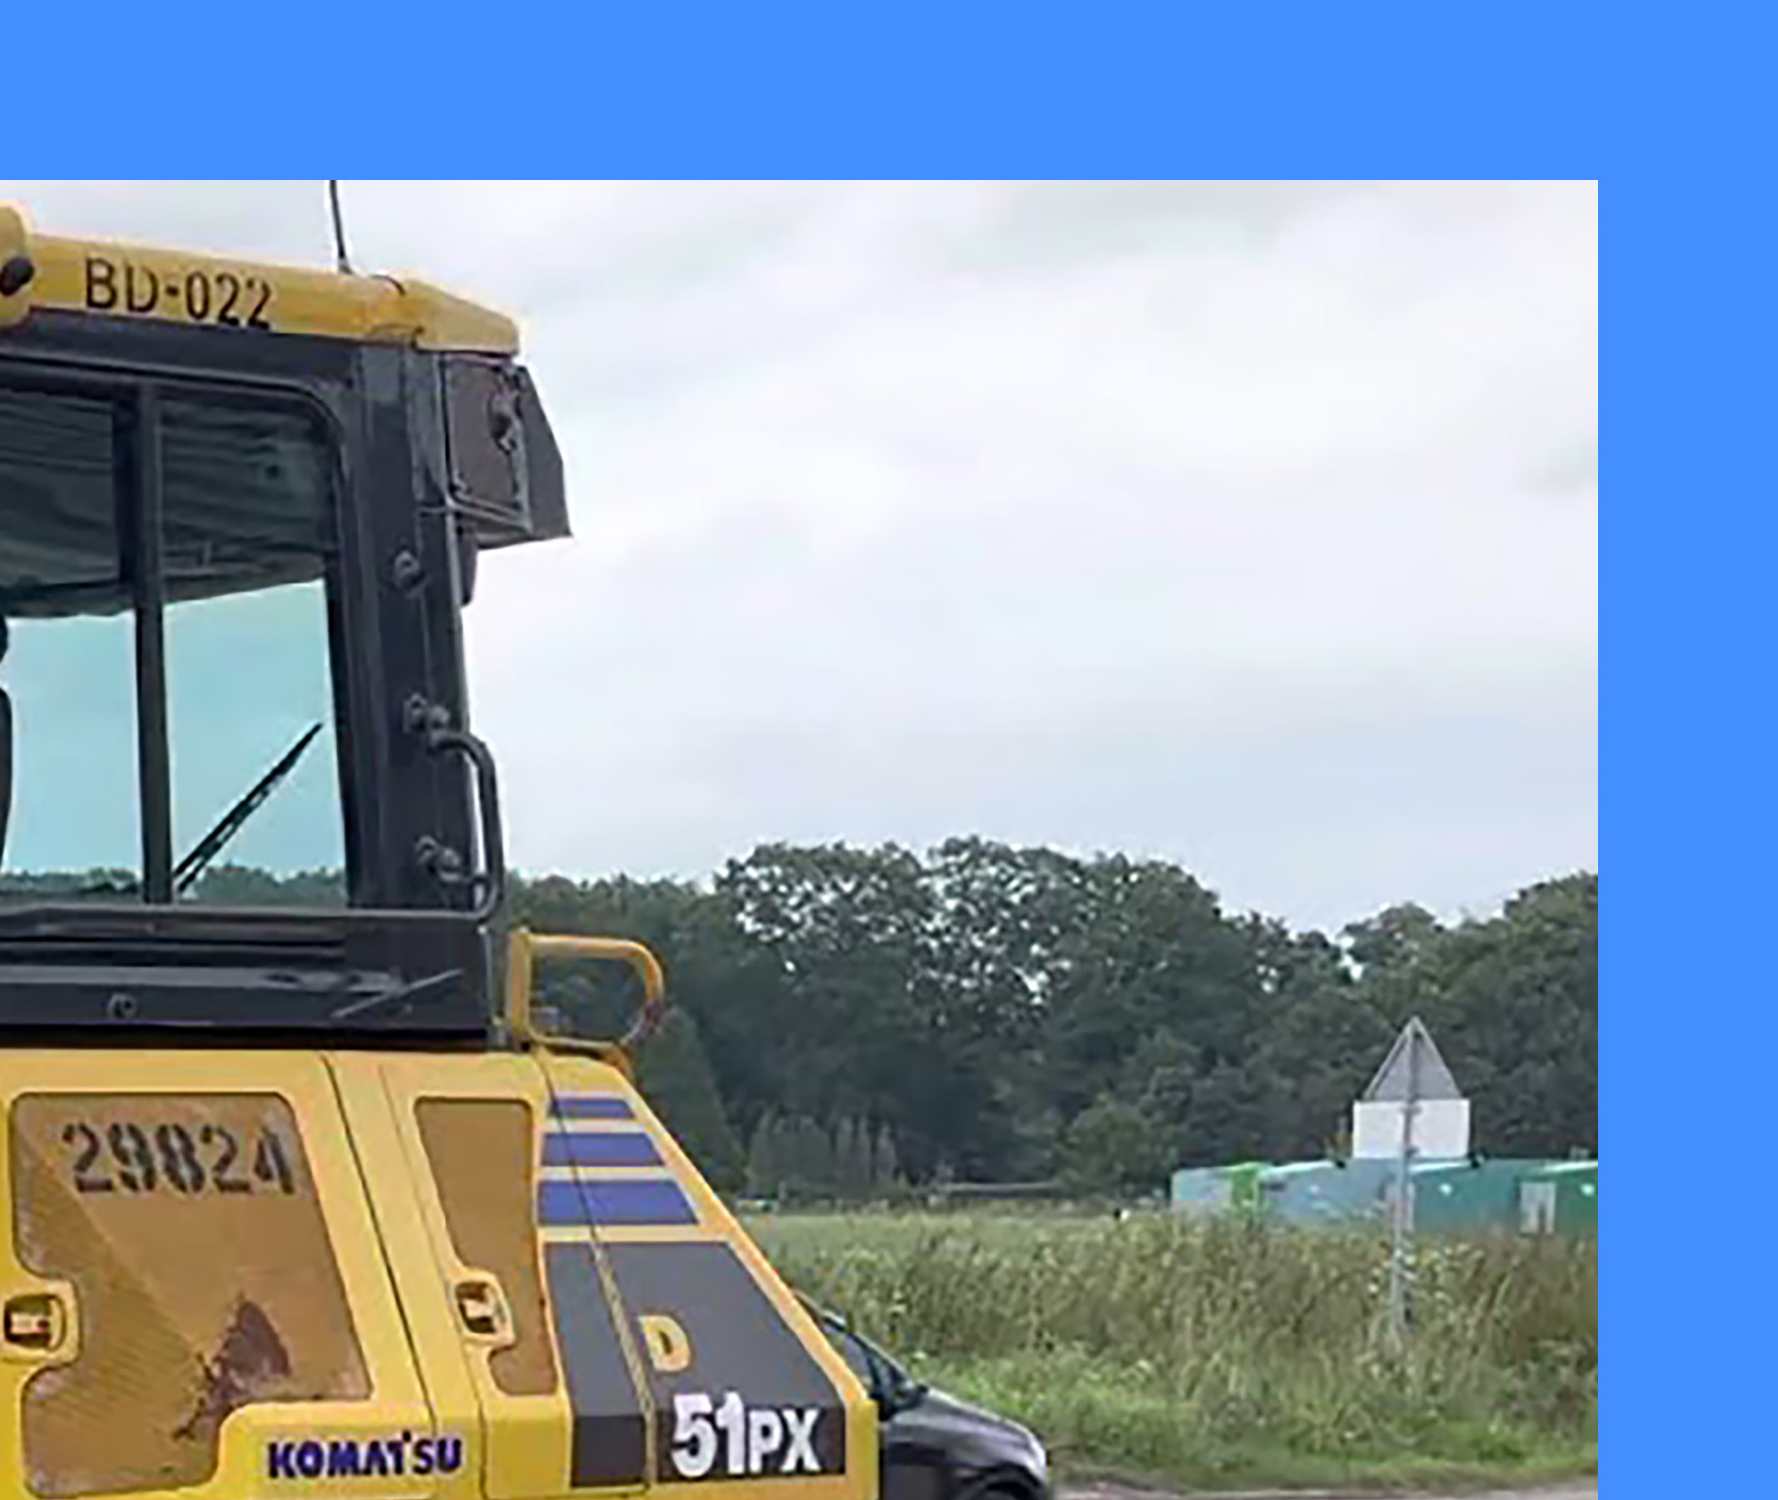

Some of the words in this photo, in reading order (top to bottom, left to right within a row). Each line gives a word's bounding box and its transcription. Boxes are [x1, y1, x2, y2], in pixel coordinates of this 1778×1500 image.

[85, 256, 272, 331] BD-022
[60, 1121, 296, 1197] 29824
[640, 1315, 693, 1373] D
[266, 1428, 462, 1479] KOMATSU
[670, 1390, 822, 1478] 51PX
